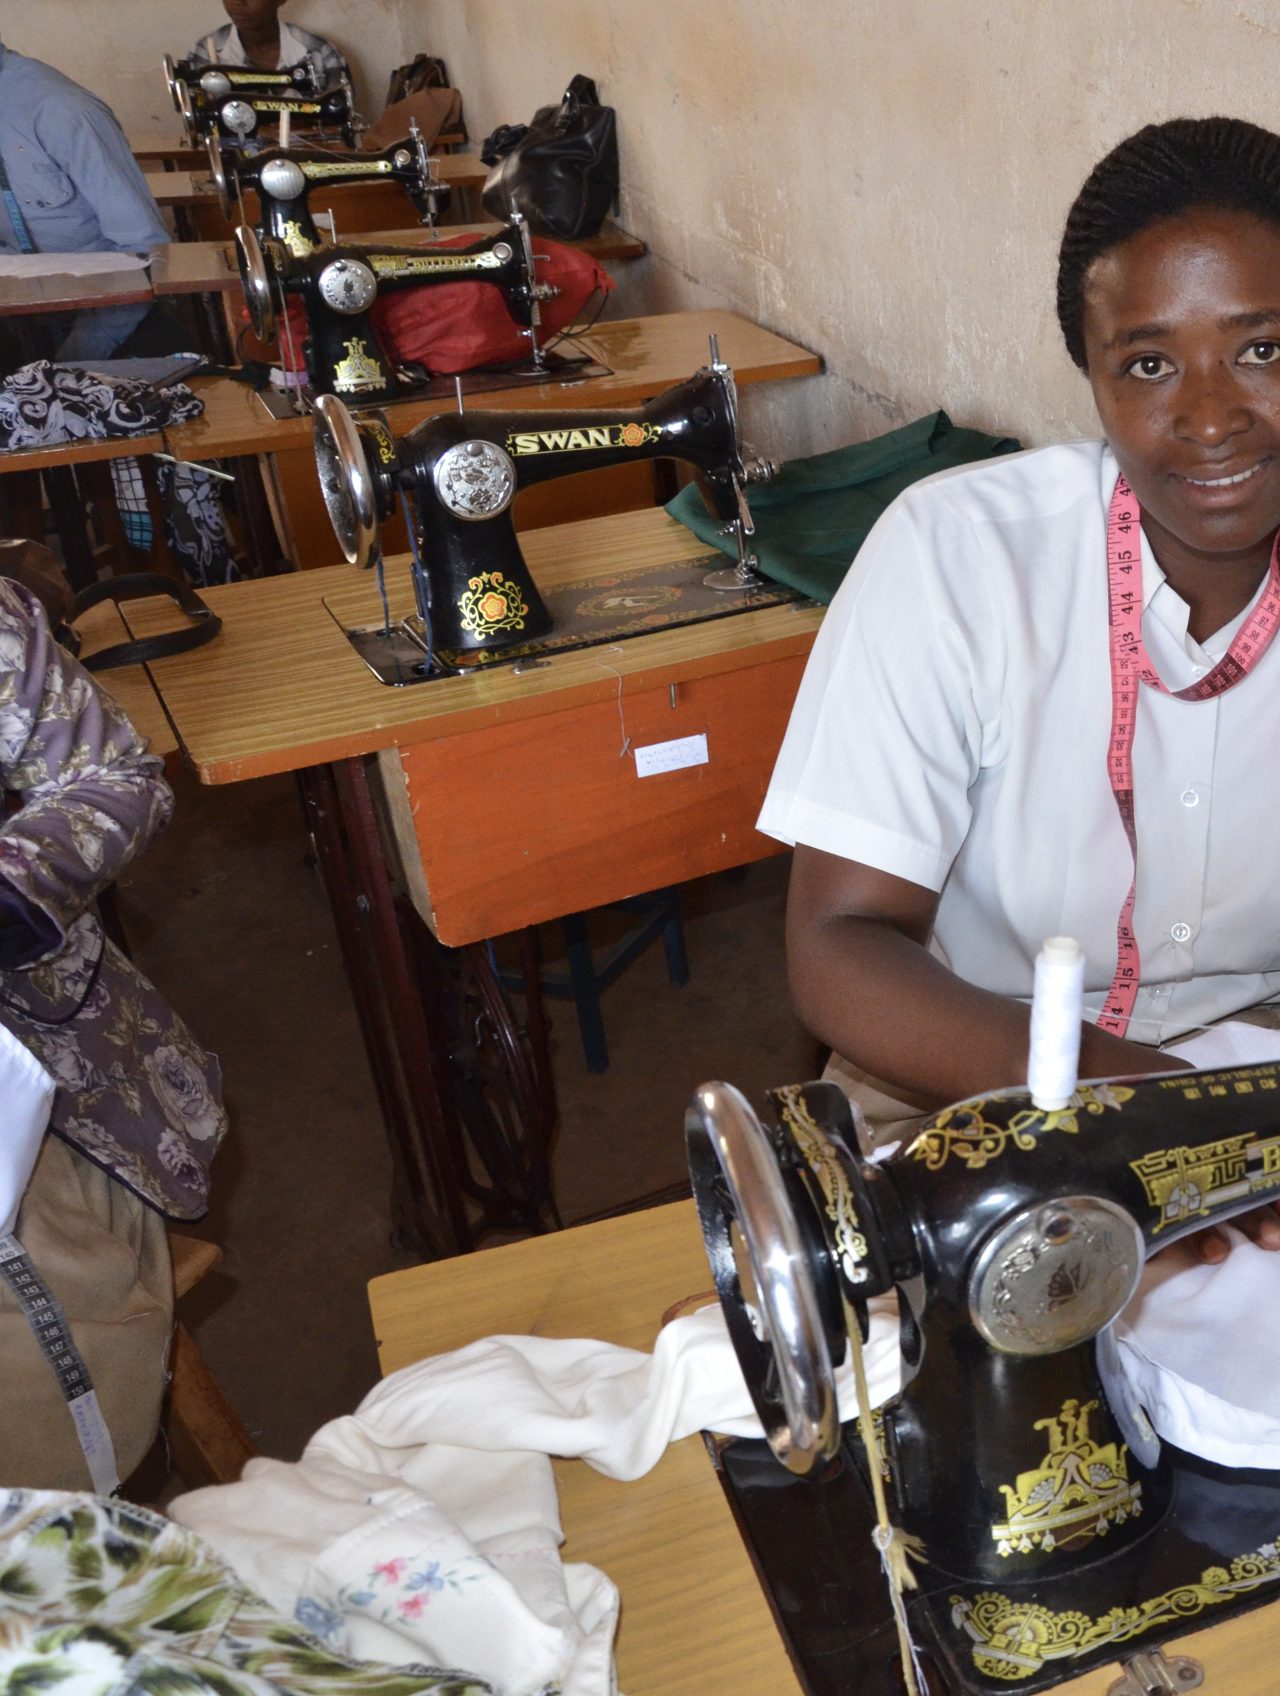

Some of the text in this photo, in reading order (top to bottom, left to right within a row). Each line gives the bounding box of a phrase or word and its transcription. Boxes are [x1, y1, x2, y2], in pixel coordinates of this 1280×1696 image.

[258, 101, 300, 111] SWAN
[413, 255, 478, 269] BUTTERFL
[514, 427, 612, 454] SWAN
[1118, 511, 1132, 534] 46
[1118, 550, 1133, 575] 45
[1121, 592, 1134, 615] 44
[1259, 616, 1269, 626] 97
[1250, 630, 1260, 640] 98
[1122, 631, 1138, 655] 43
[1235, 652, 1246, 665] 100
[1121, 926, 1134, 949] 16
[1119, 967, 1134, 990] 15
[1106, 1007, 1124, 1029] 14
[7, 1262, 23, 1272] 141
[31, 1297, 47, 1309] 144
[38, 1311, 54, 1324] 145
[44, 1326, 60, 1339] 146
[50, 1341, 64, 1353] 147
[71, 1385, 85, 1397] 150
